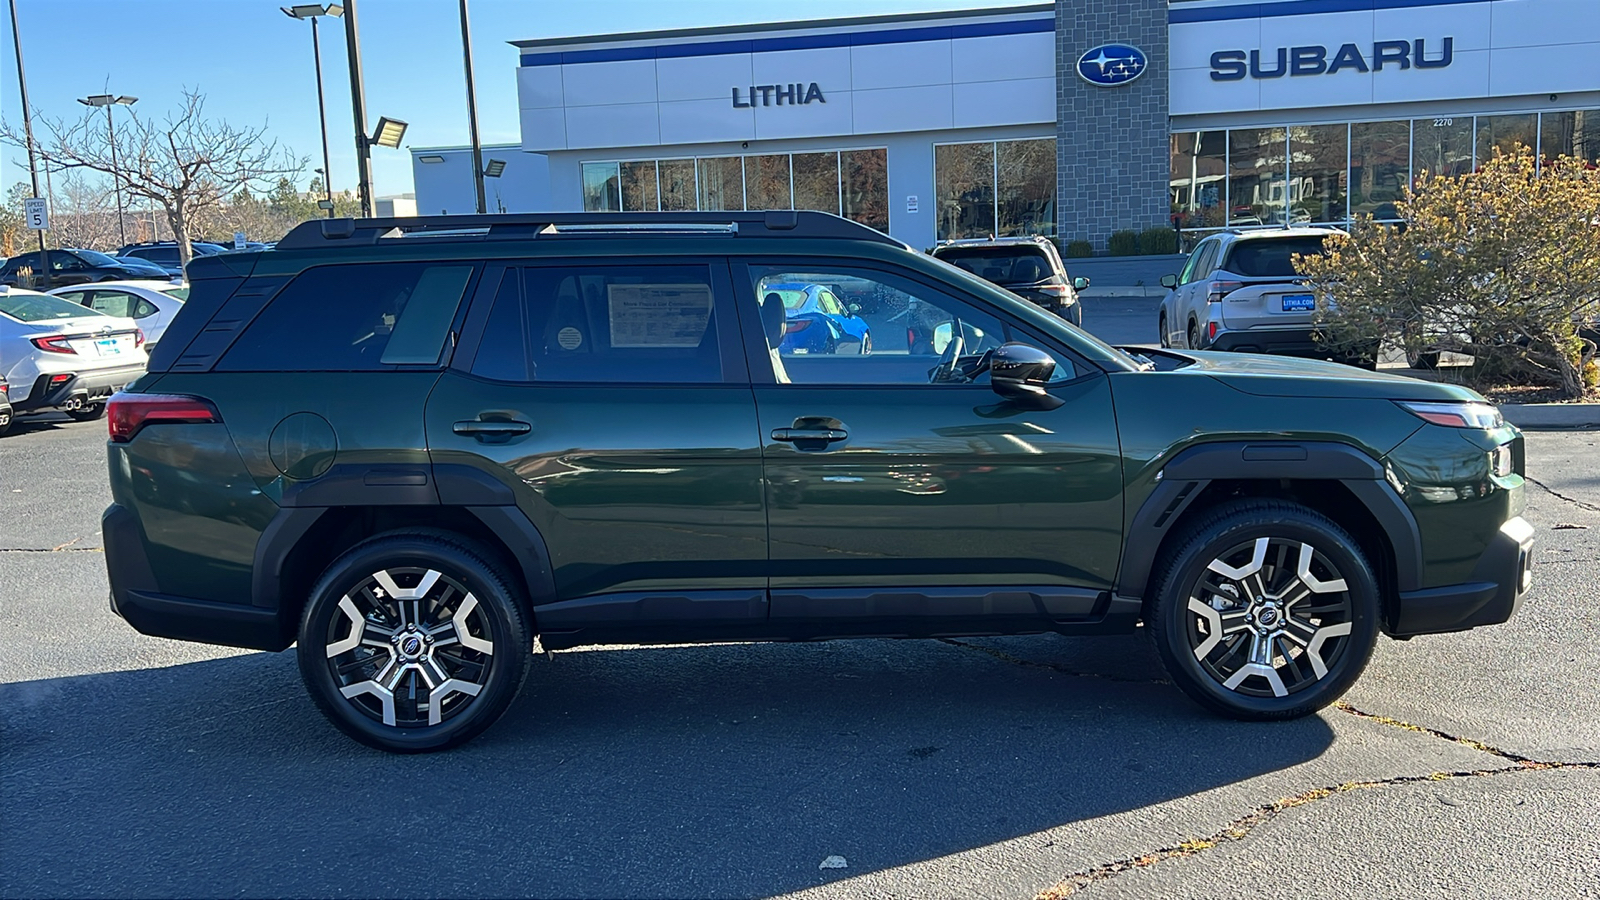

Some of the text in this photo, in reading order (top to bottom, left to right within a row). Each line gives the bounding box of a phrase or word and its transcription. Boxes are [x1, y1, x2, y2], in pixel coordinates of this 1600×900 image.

[1209, 36, 1453, 82] SUBARU
[732, 82, 826, 108] LITHIA
[1433, 118, 1453, 127] 2270
[34, 214, 42, 226] 5
